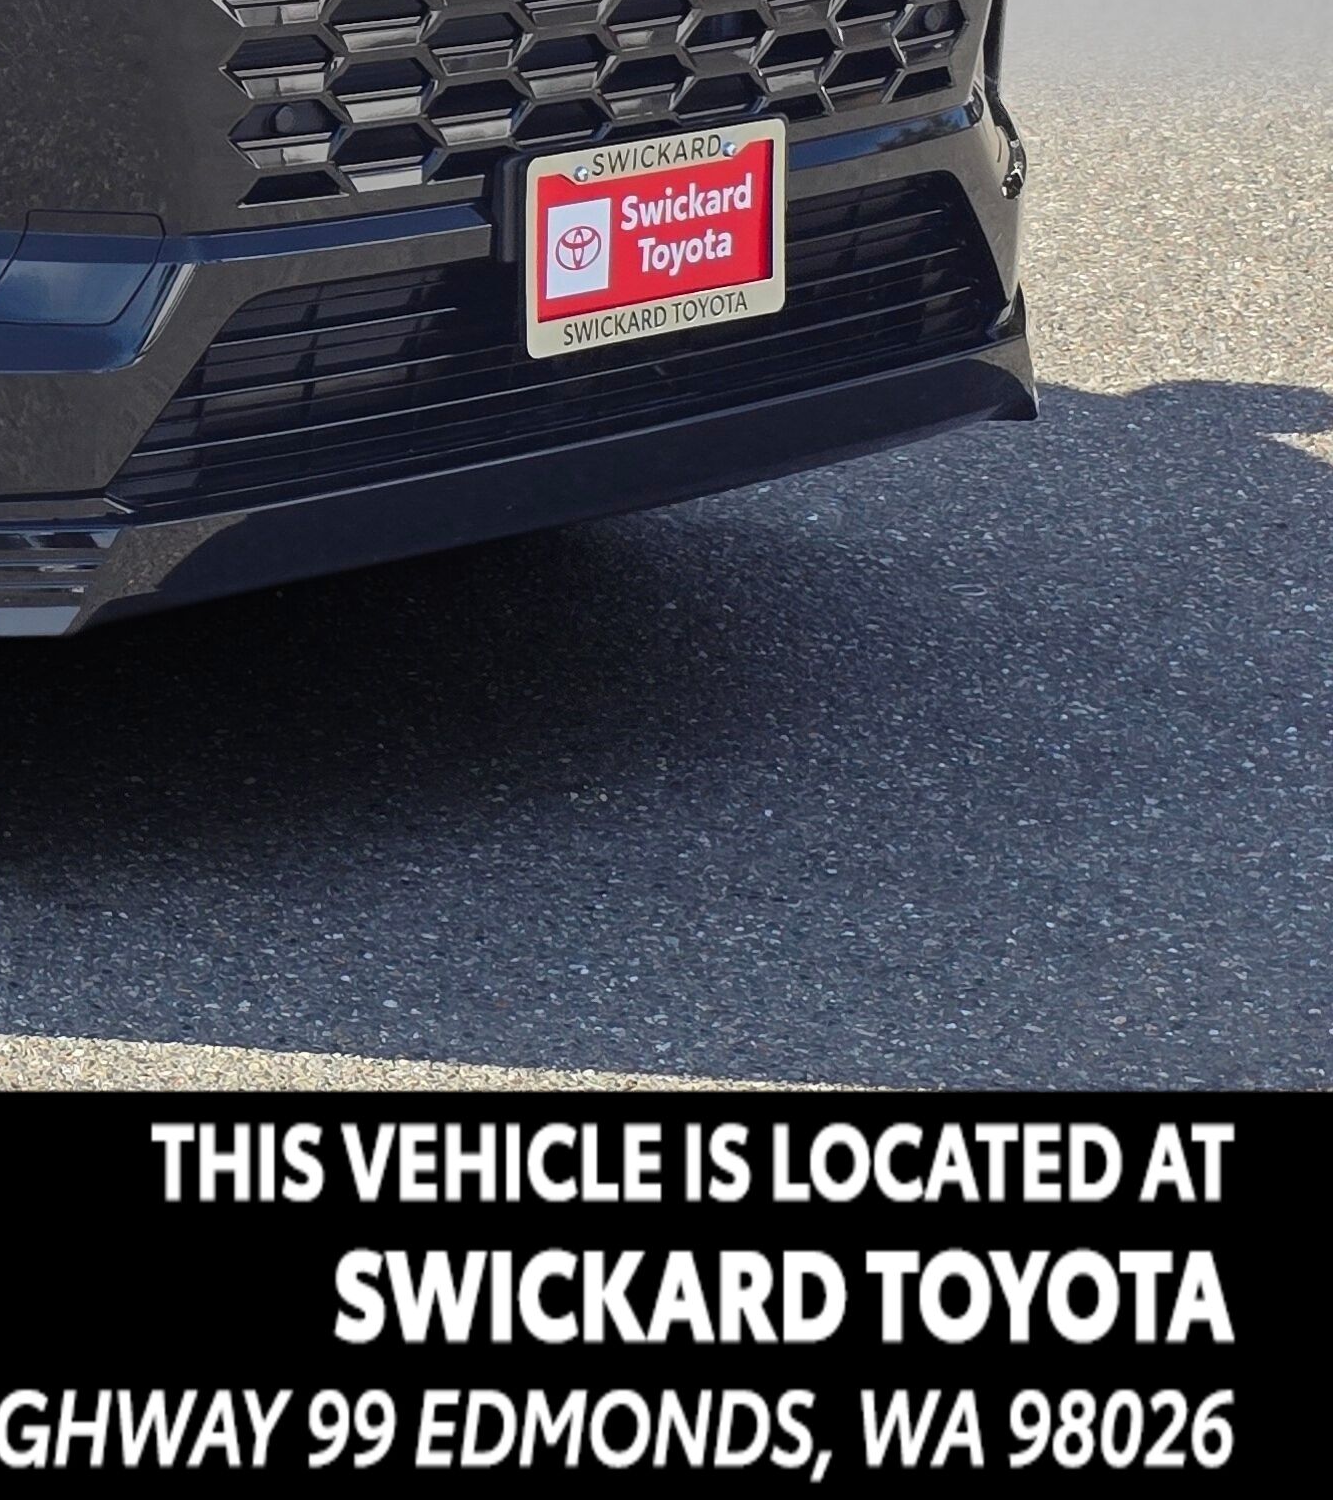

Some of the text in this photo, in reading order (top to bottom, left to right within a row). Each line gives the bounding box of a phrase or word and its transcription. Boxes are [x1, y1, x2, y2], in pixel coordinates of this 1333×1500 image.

[591, 133, 722, 177] SWICKARD
[620, 172, 753, 231] Swickard
[637, 228, 733, 276] Toyota
[563, 290, 748, 346] SWICKARD TOYOTA
